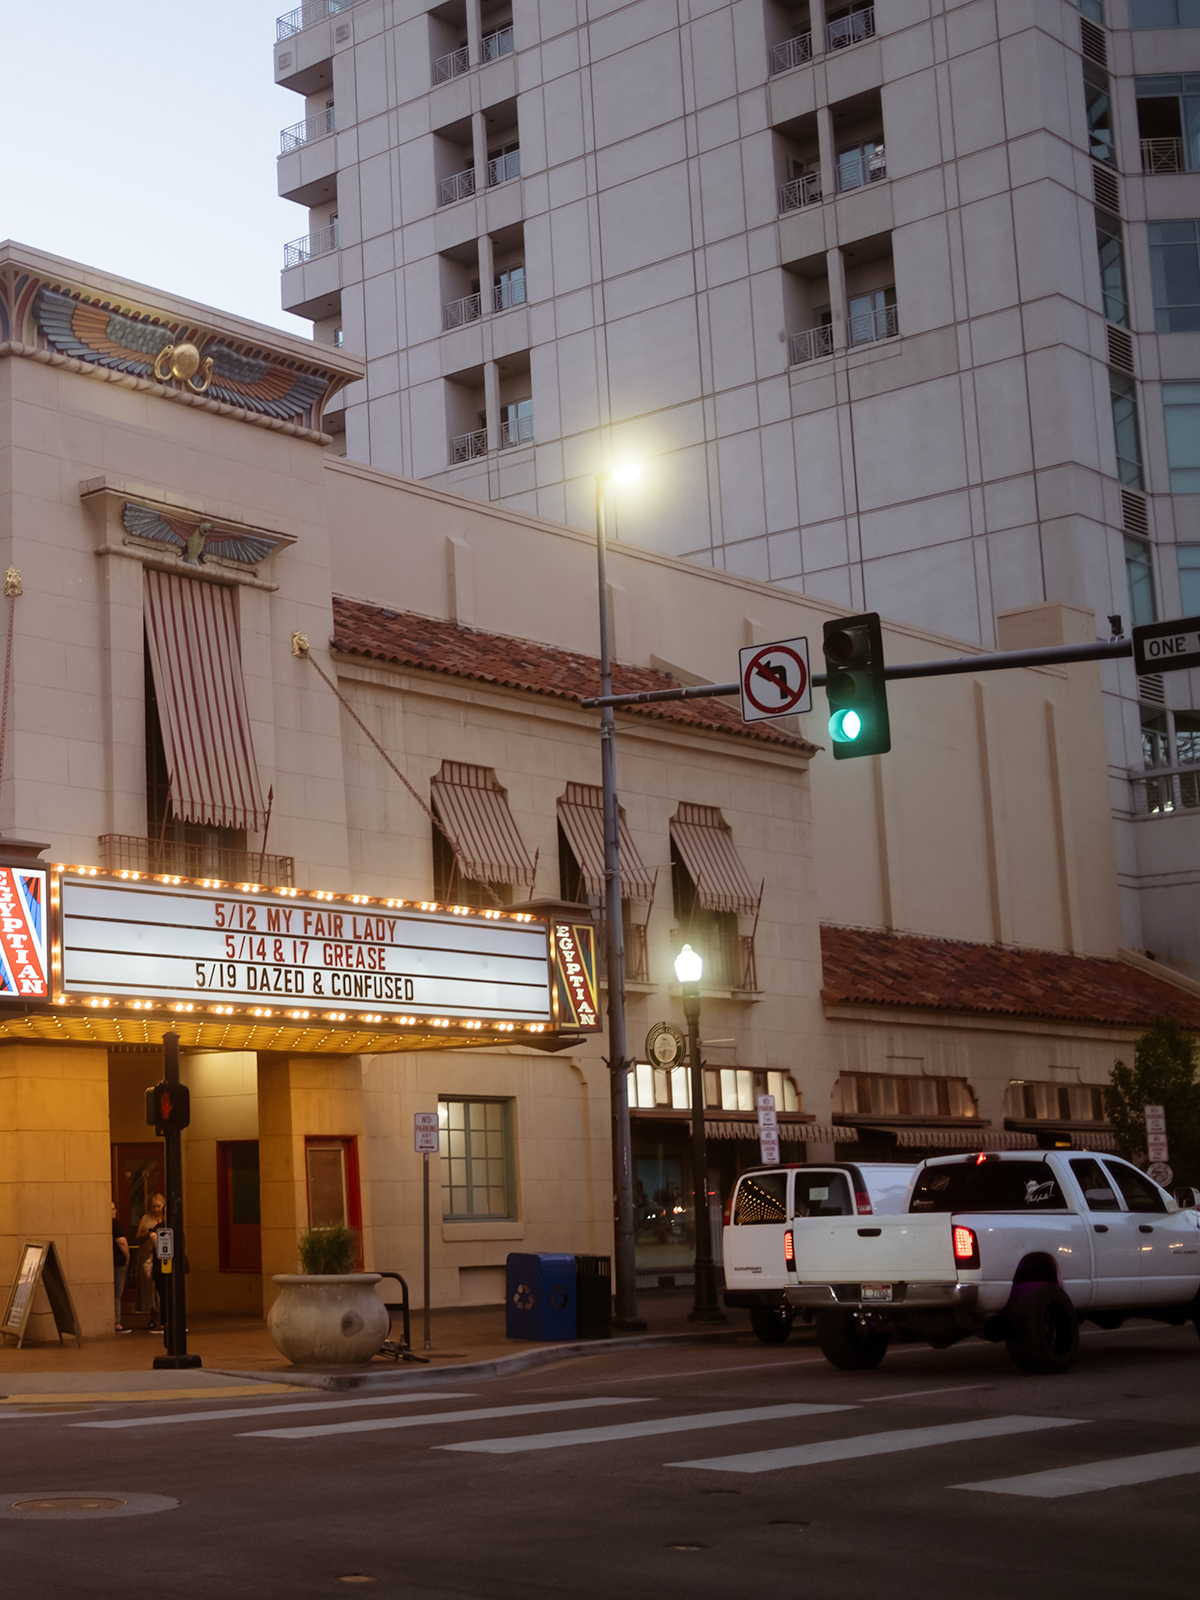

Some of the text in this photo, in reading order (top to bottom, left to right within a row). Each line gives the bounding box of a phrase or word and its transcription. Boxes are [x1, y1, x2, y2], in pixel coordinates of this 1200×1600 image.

[1149, 636, 1186, 657] ONE
[214, 903, 397, 942] 5/12 MY FAIR LADY
[225, 934, 386, 970] 5/14 & 17 GREASE
[195, 962, 414, 1001] 5/19 DAZED & CONFUSED
[556, 925, 596, 1025] EGYPTIAN
[421, 1116, 431, 1124] NO
